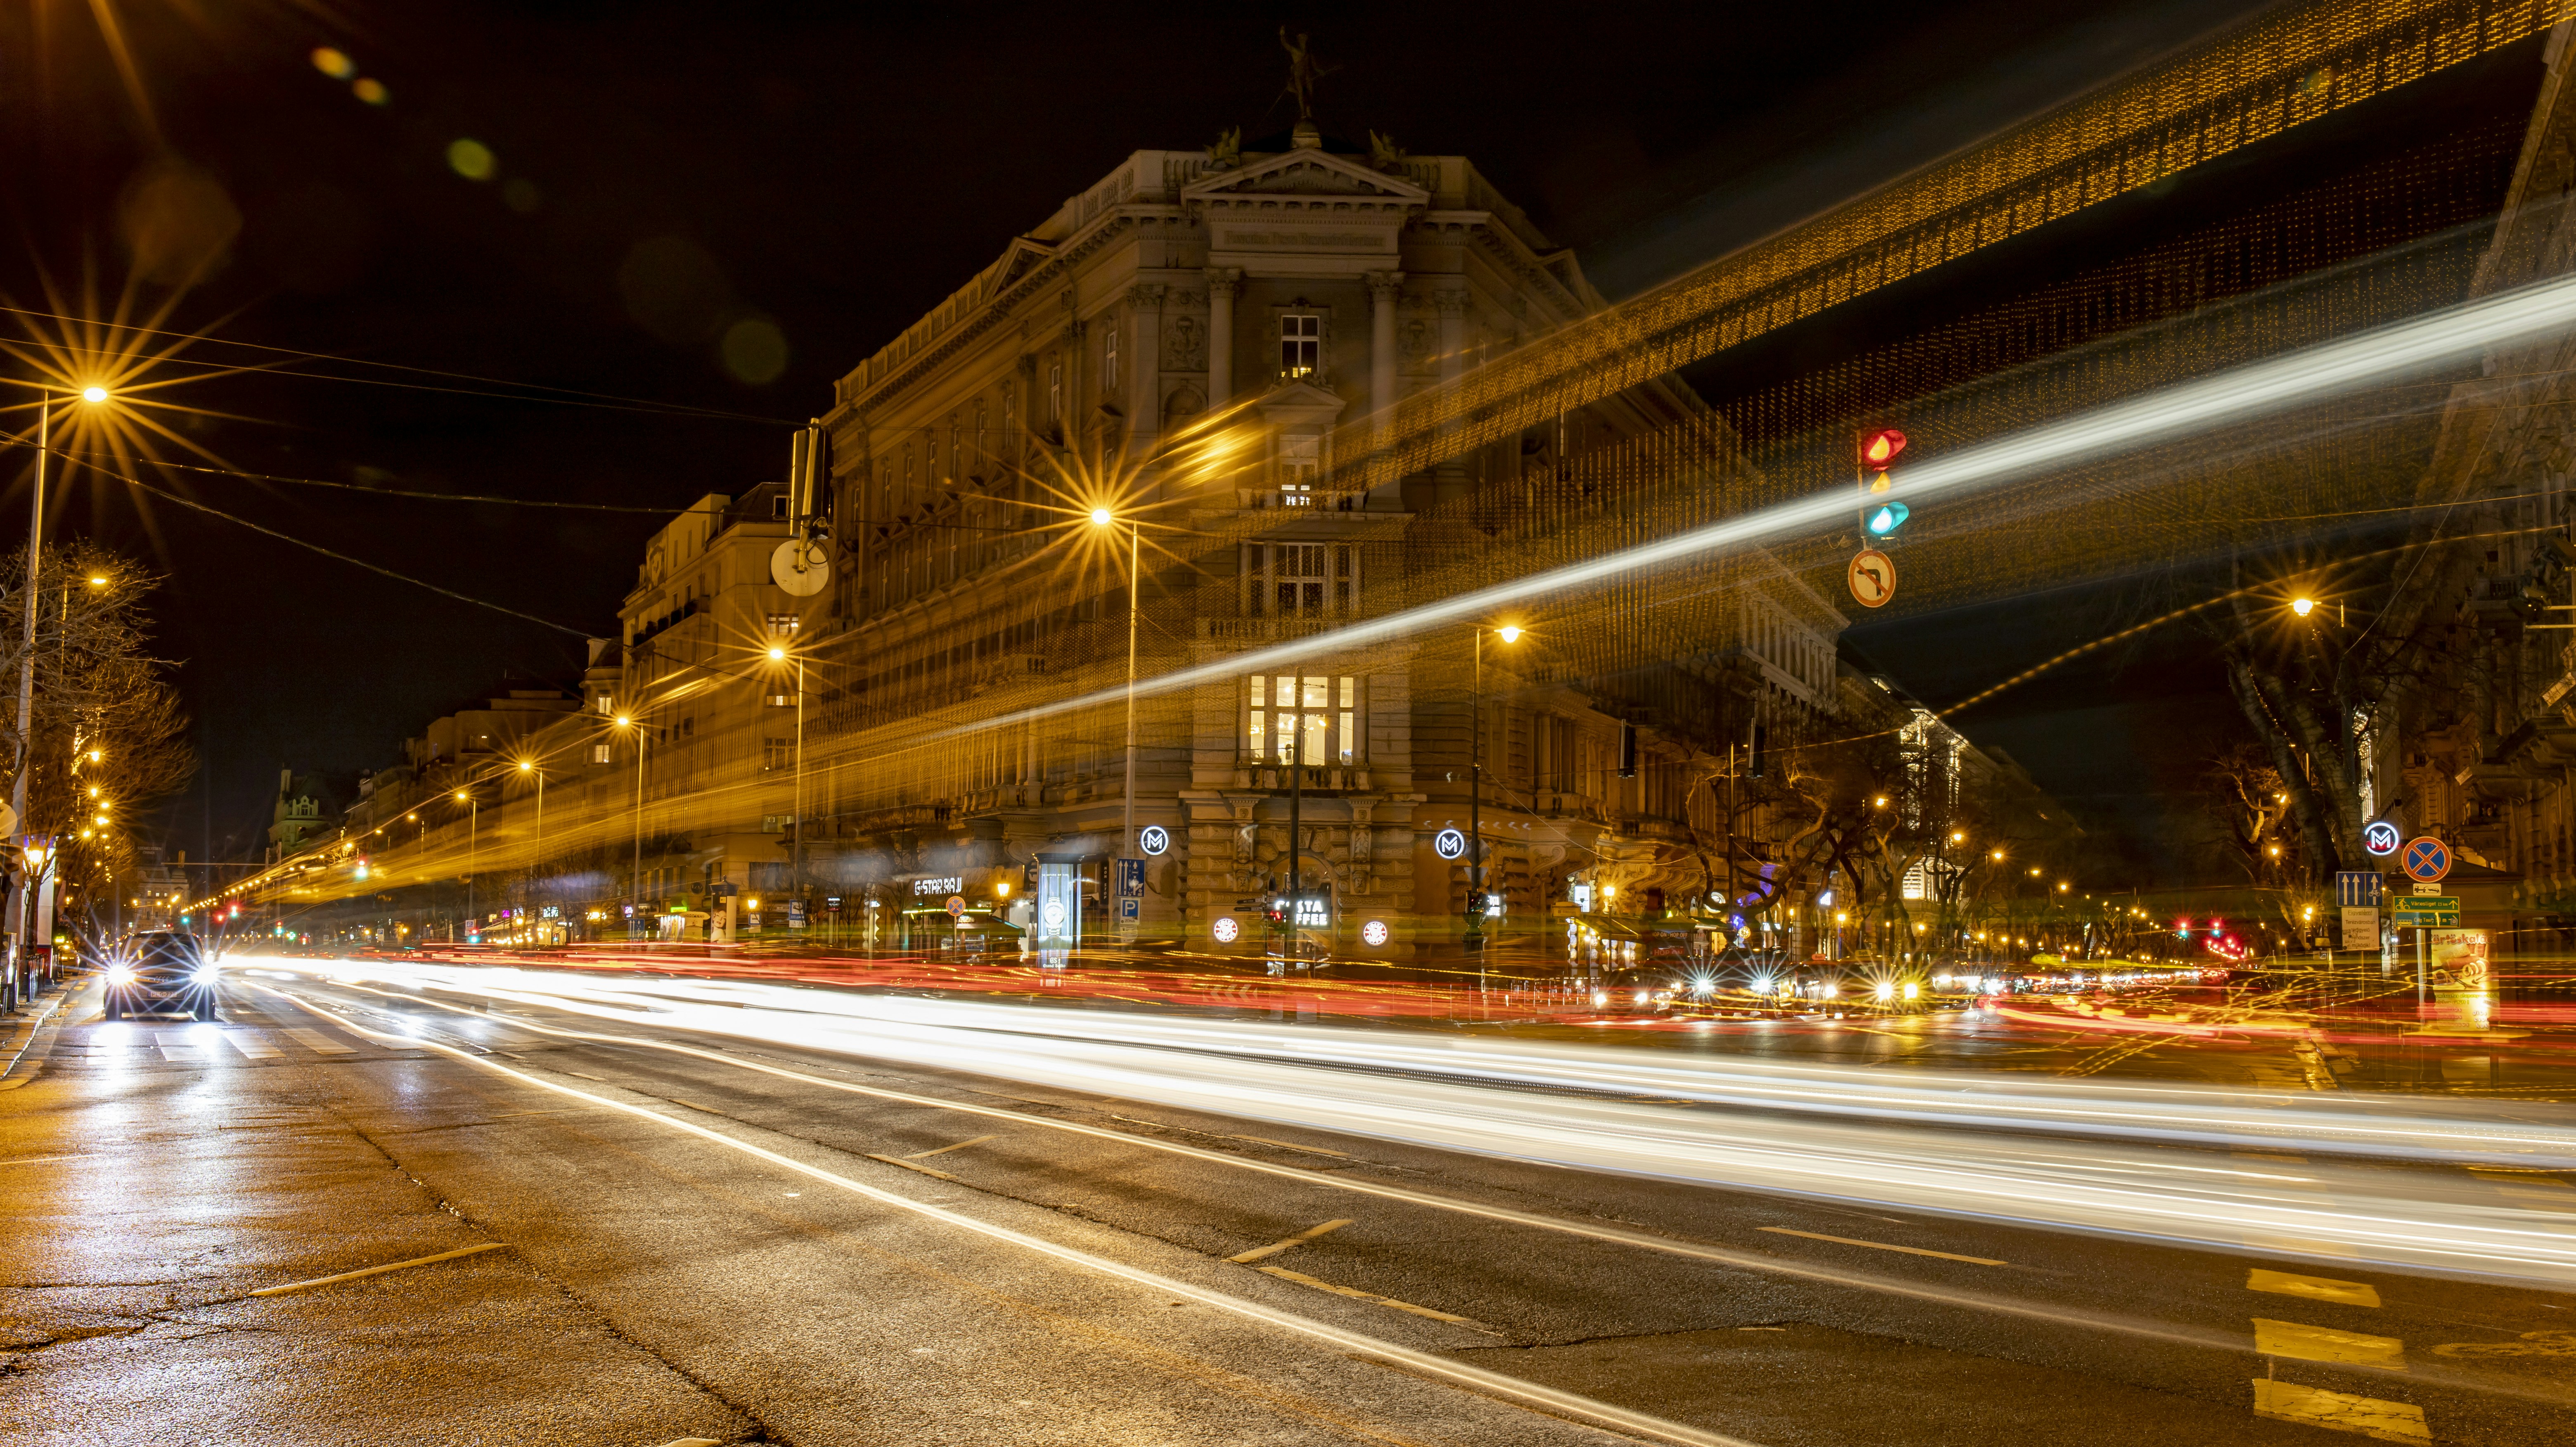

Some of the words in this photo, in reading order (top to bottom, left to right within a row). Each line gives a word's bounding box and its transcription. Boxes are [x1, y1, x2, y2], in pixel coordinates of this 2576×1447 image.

[1125, 901, 1136, 915] P
[1275, 900, 1323, 913] CSTA
[2432, 933, 2497, 944] ürtöskalács
